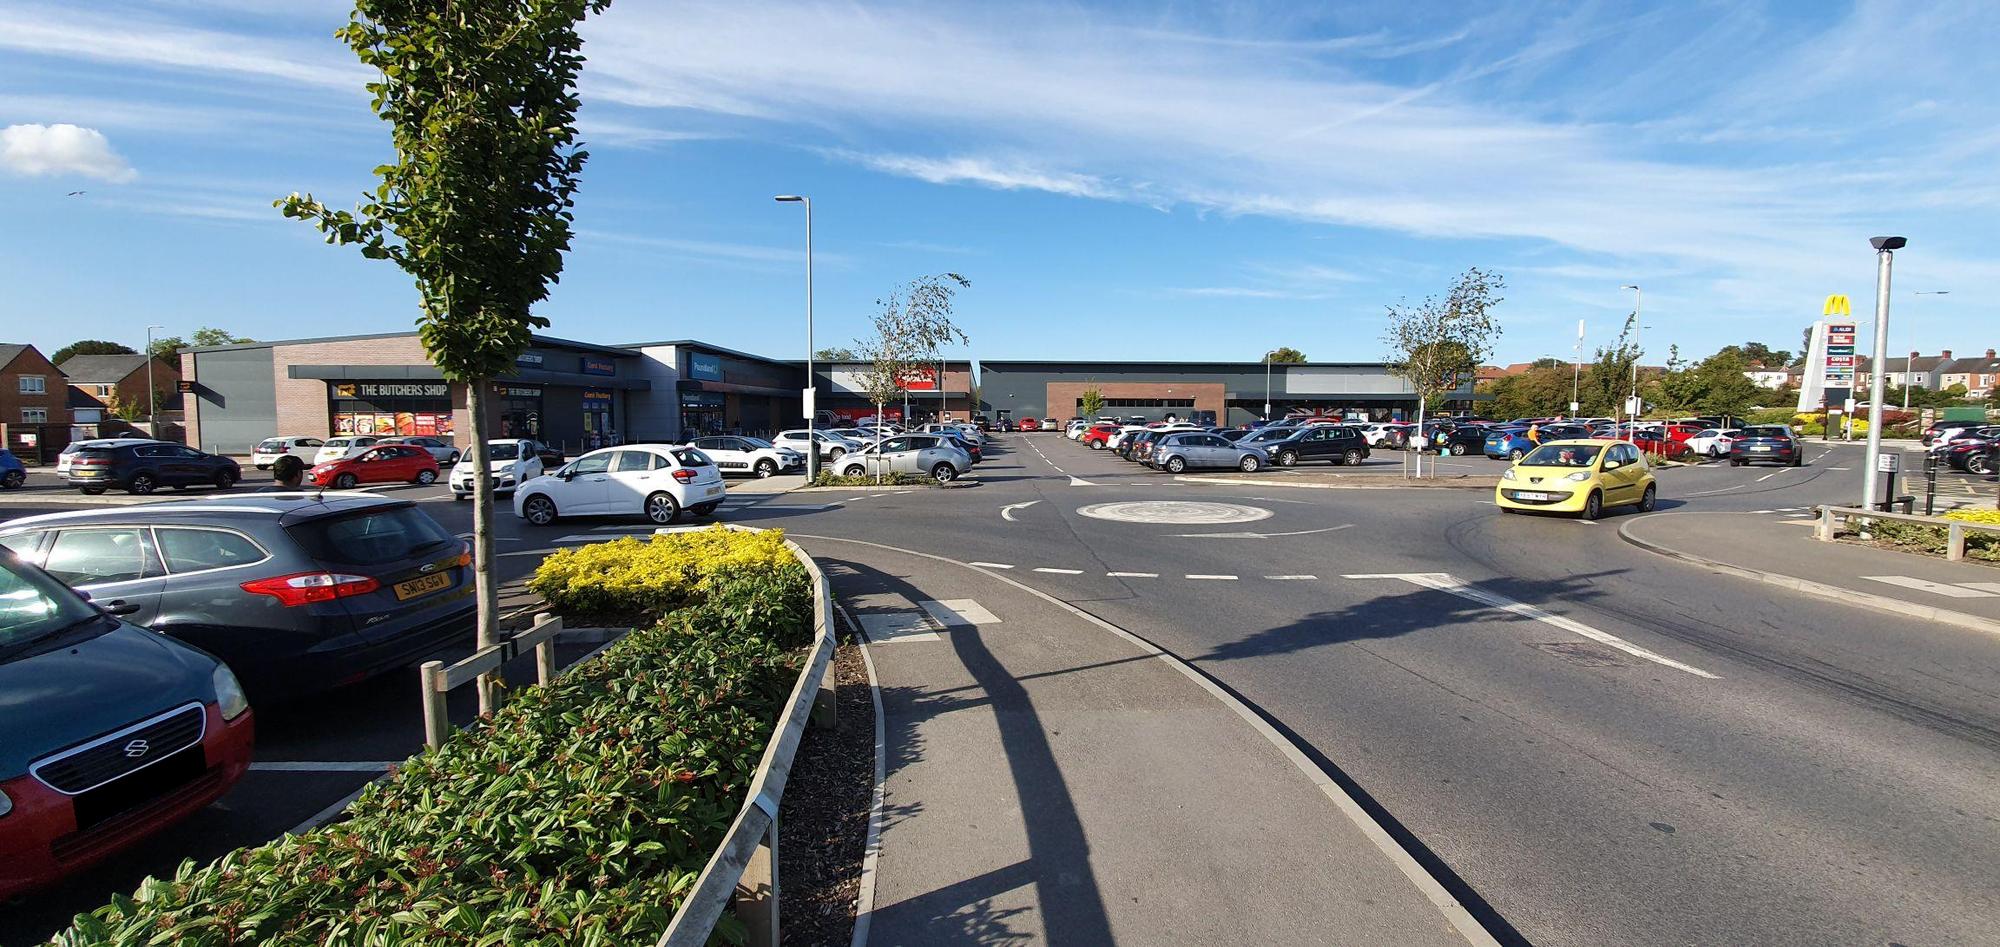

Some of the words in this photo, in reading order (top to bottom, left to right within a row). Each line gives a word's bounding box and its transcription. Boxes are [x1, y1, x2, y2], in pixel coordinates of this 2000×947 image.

[361, 385, 379, 396] THE
[379, 385, 423, 396] BUTCHERS
[424, 385, 447, 396] SHOP
[402, 579, 426, 595] SN13
